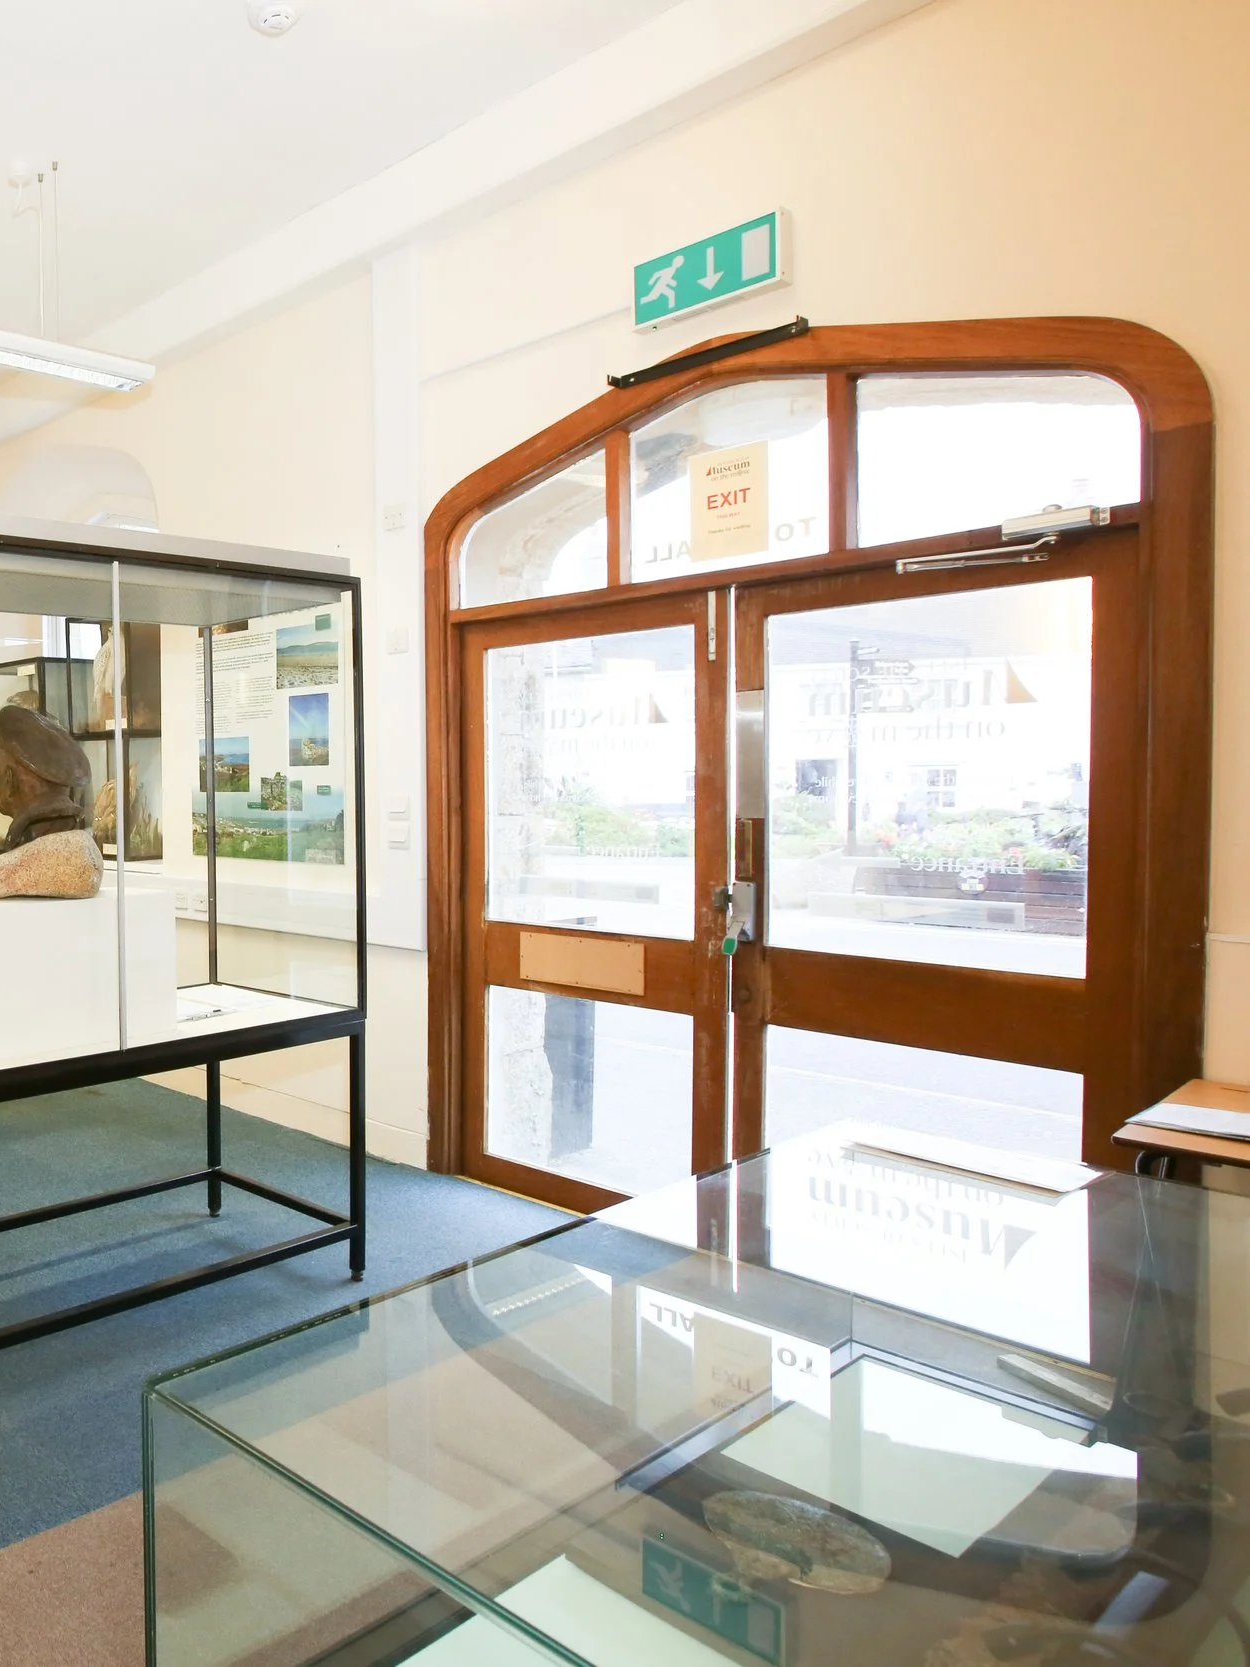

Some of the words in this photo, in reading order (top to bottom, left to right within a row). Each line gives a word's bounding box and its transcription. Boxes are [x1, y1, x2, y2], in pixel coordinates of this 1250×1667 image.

[706, 461, 750, 476] Museum
[707, 488, 750, 510] EXIT
[808, 1176, 1037, 1271] Museum
